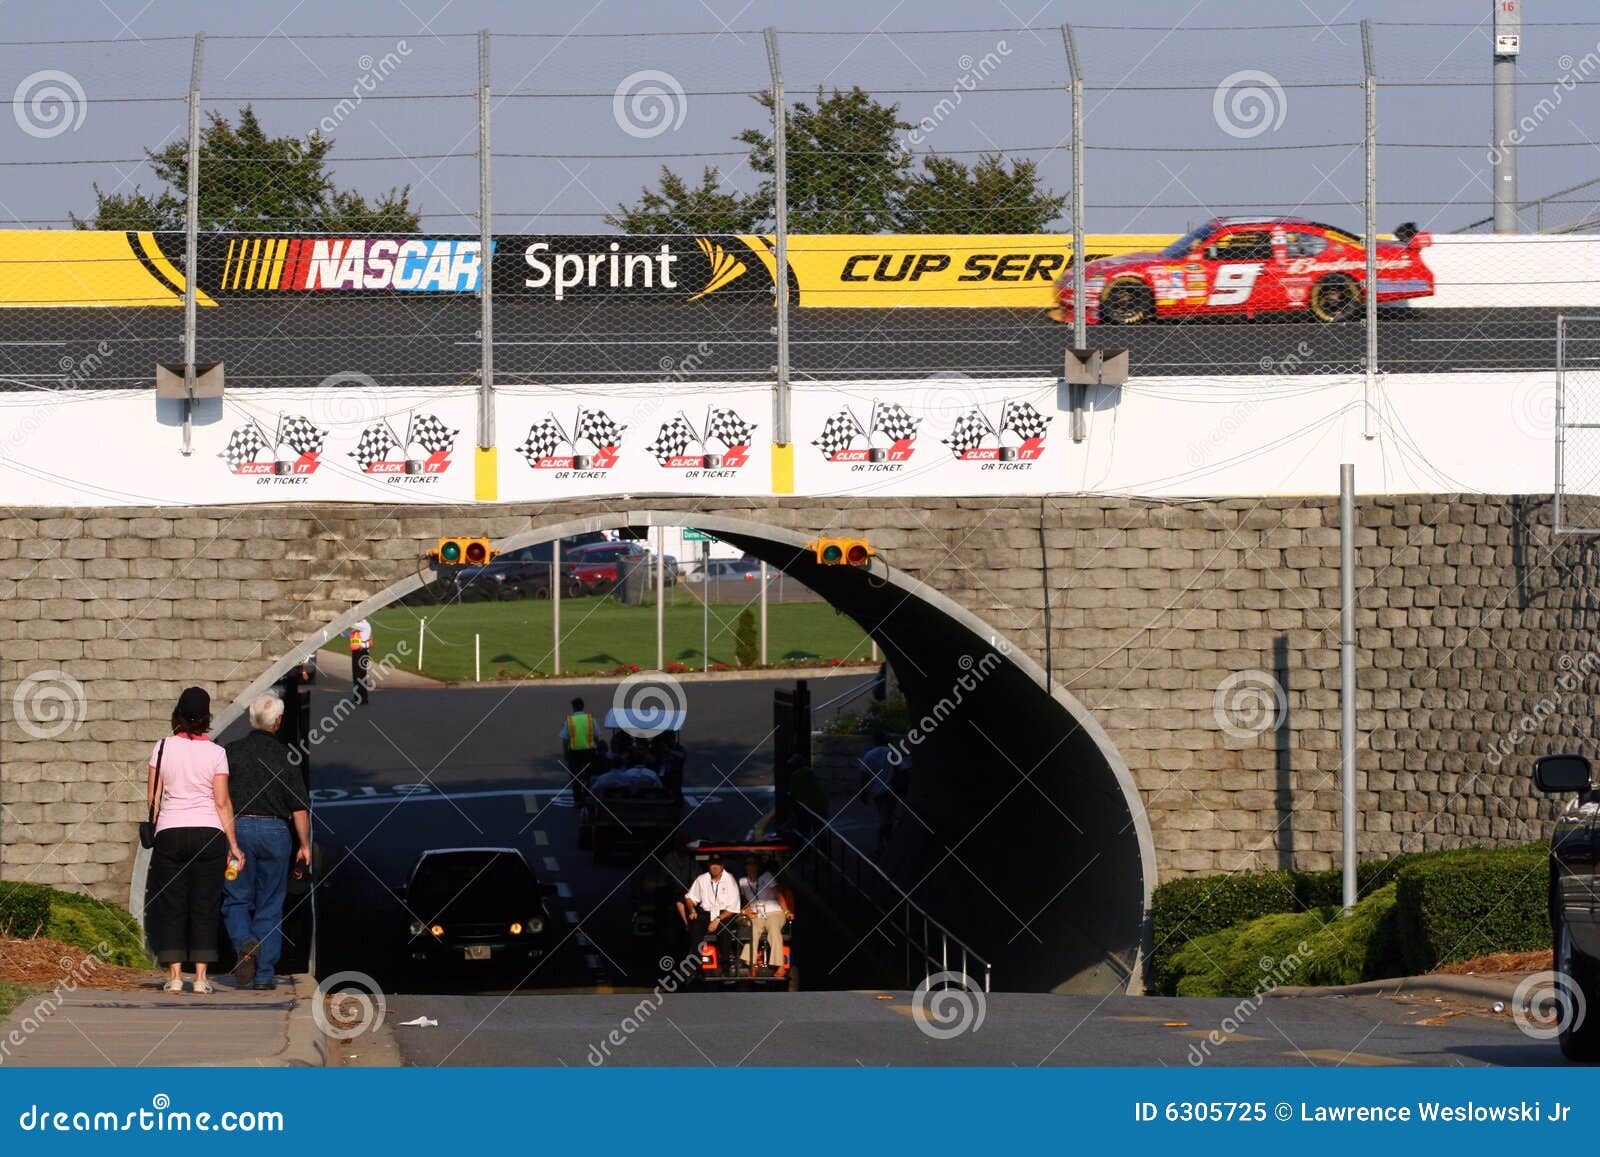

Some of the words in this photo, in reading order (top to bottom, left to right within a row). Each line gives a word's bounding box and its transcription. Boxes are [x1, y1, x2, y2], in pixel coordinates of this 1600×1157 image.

[305, 240, 481, 289] NASCAR
[525, 243, 677, 300] Sprint
[840, 254, 951, 282] CUP
[957, 253, 1113, 281] SER
[1207, 263, 1262, 306] 9
[835, 452, 867, 461] CLICK
[891, 451, 904, 460] IT
[966, 450, 996, 459] CLICK
[1021, 450, 1033, 459] IT
[540, 459, 570, 468] CLICK
[596, 458, 609, 467] IT
[670, 458, 701, 467] CLICK
[726, 457, 738, 466] IT
[241, 465, 272, 473] CLICK
[297, 464, 309, 473] IT
[372, 464, 404, 472] CLICK
[427, 463, 440, 472] IT
[851, 464, 865, 472] OR
[981, 463, 994, 471] OR
[555, 471, 568, 479] OR
[685, 470, 699, 478] OR
[256, 477, 270, 485] OR
[387, 476, 401, 484] OR
